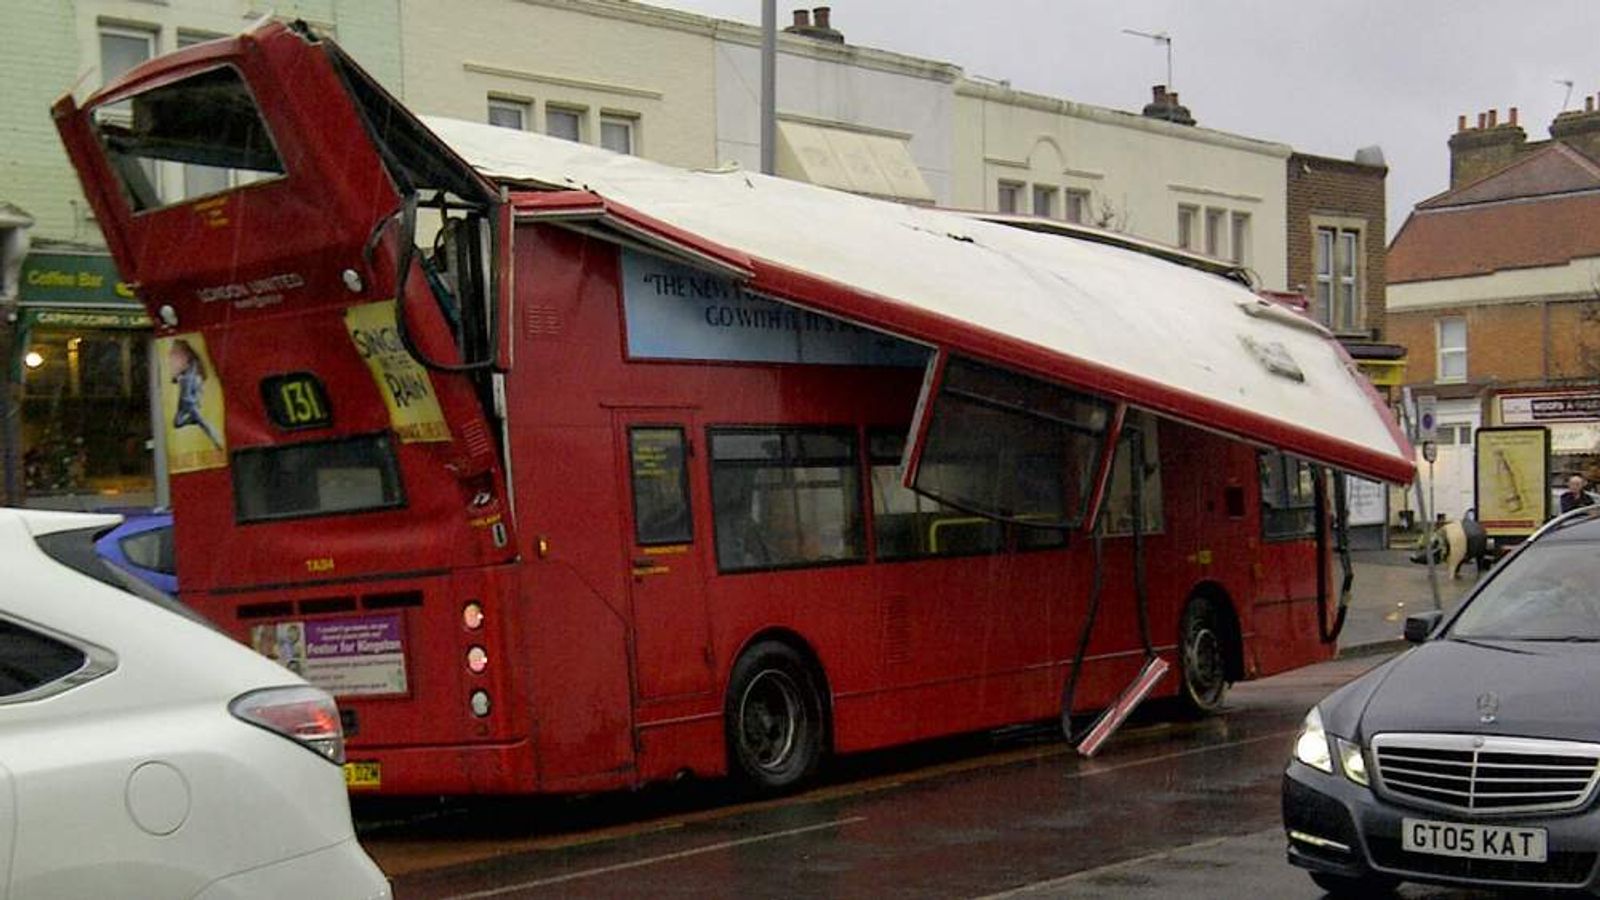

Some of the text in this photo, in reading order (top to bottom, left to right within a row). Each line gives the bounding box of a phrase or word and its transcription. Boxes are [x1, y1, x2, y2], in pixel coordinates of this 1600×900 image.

[28, 269, 104, 287] Coffee Bar
[246, 273, 304, 294] UNITED
[705, 306, 734, 328] GO
[384, 372, 428, 408] RAIN
[281, 382, 321, 422] 131
[340, 640, 355, 654] for
[357, 639, 402, 655] Kingston
[1413, 824, 1534, 857] GT05 KAT
